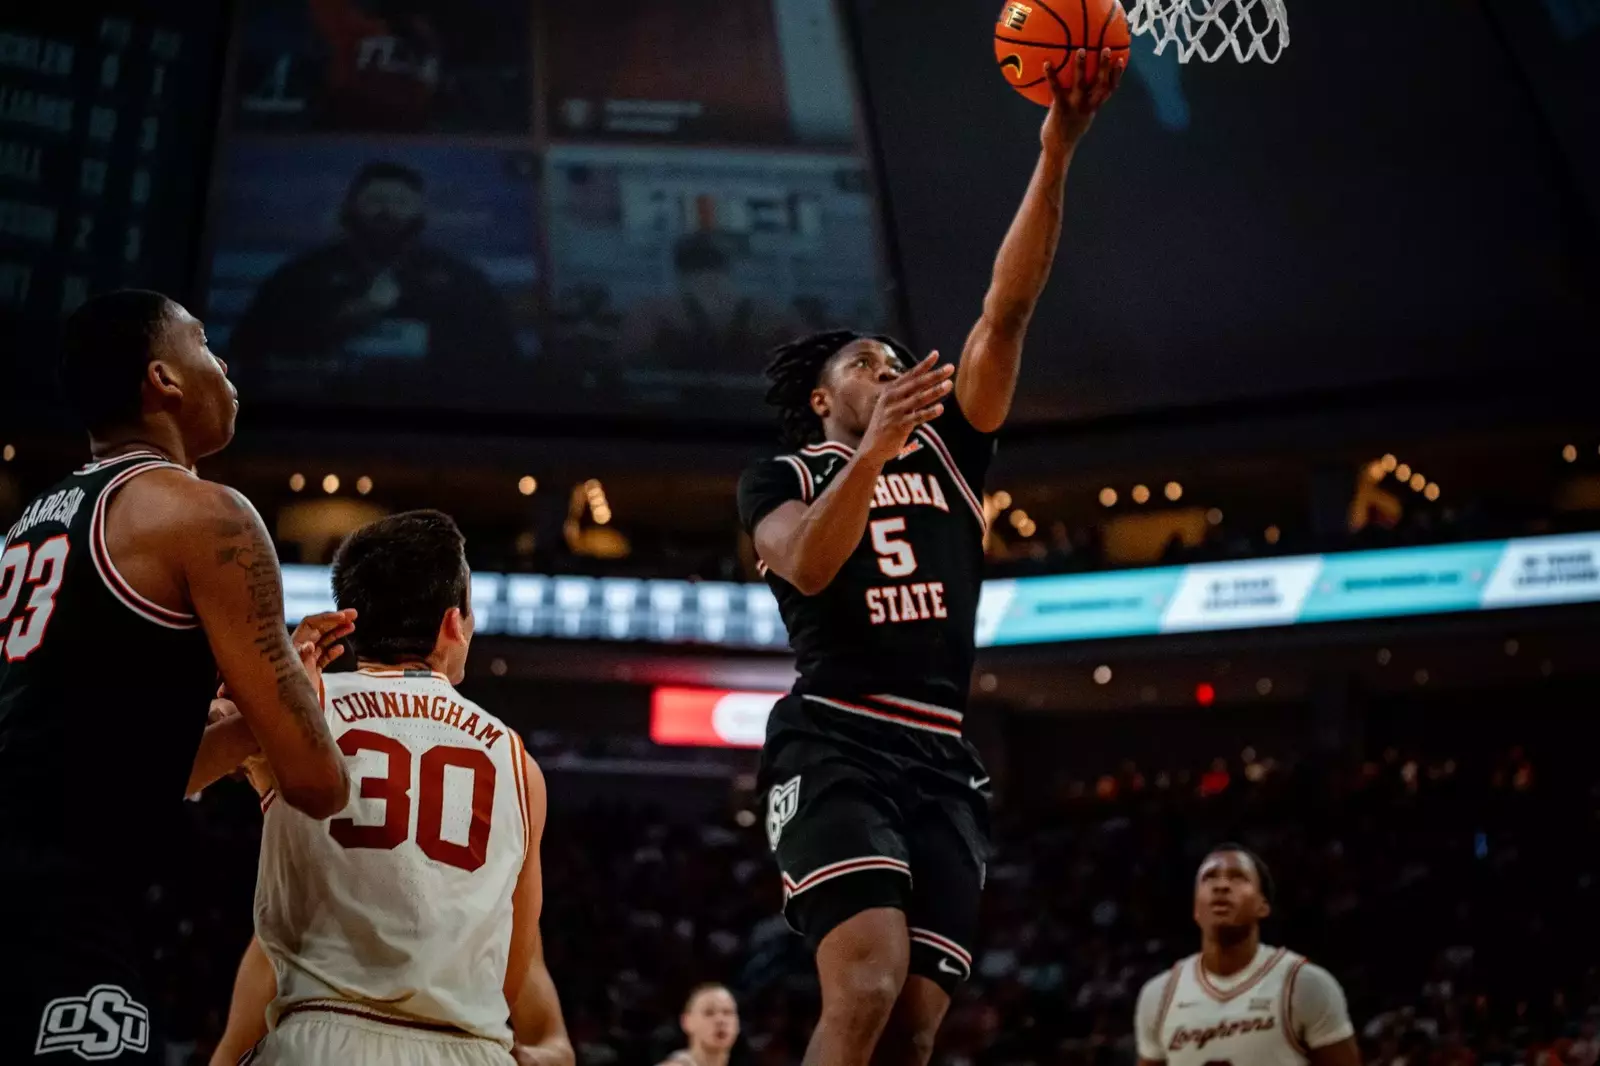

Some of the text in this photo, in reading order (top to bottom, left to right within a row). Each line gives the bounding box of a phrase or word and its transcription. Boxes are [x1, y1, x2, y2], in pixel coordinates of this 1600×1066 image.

[870, 473, 951, 513] HOMA
[869, 517, 918, 578] 5
[865, 582, 948, 625] STATE
[331, 691, 505, 750] CUNNINGHAM
[328, 728, 497, 873] 30
[35, 983, 149, 1060] OSU
